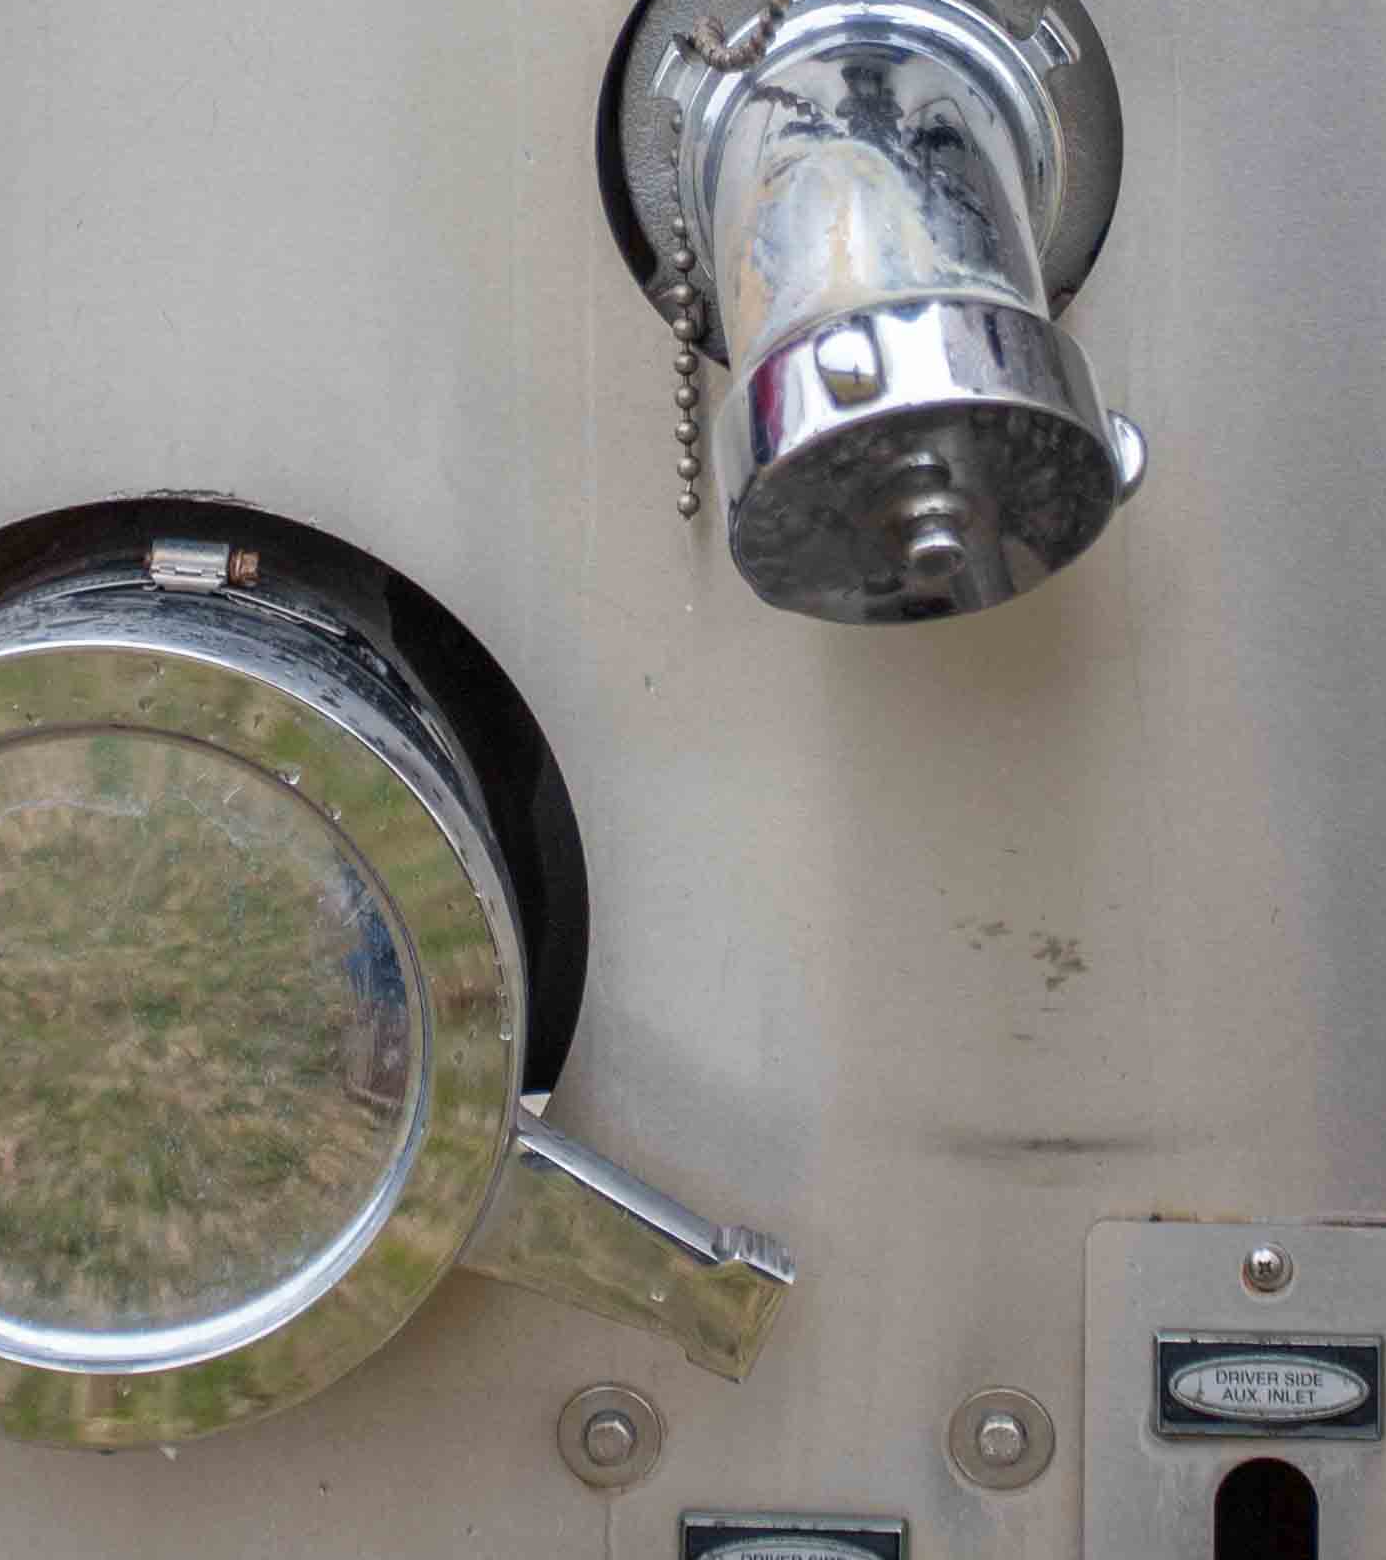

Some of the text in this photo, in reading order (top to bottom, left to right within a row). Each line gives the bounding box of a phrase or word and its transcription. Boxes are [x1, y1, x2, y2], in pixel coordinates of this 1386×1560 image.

[1215, 1370, 1323, 1387] DRIVER SIDE
[1222, 1388, 1316, 1404] AUX. INLET
